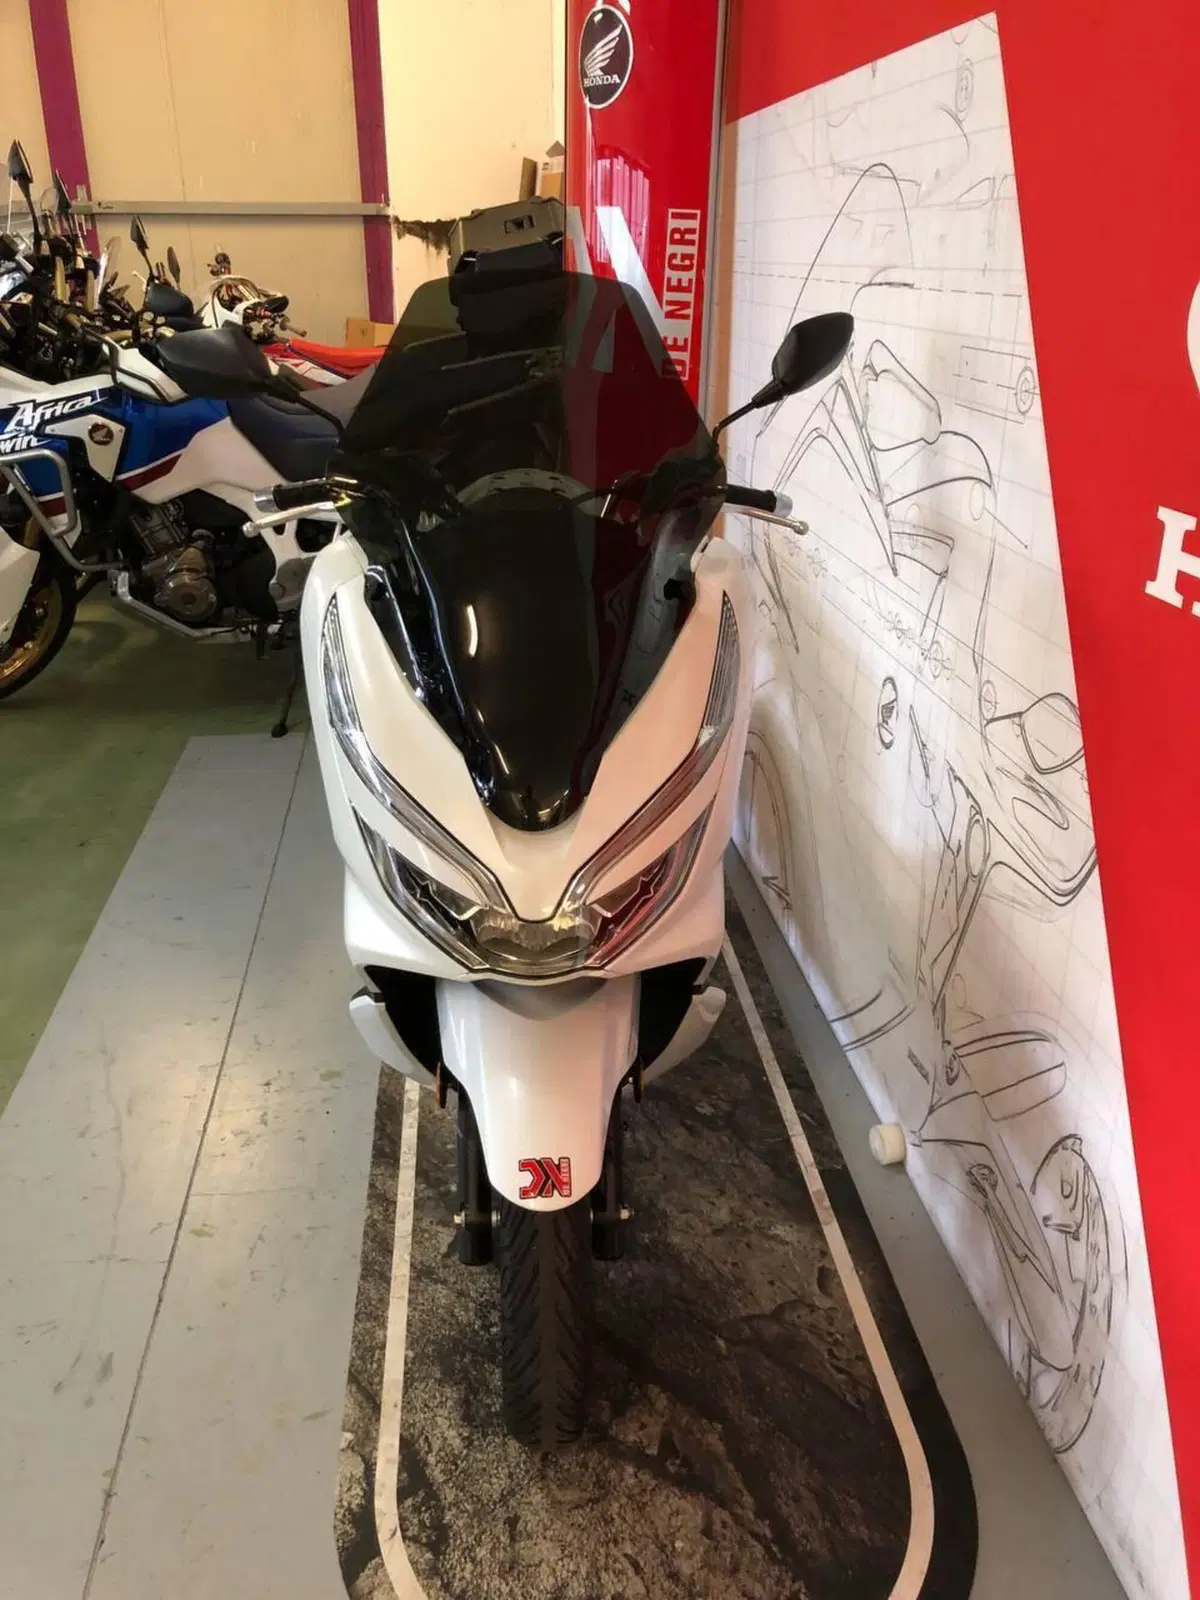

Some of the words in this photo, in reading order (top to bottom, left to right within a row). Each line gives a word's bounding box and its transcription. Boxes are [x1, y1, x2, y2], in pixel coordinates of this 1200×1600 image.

[583, 73, 621, 88] HONDA
[664, 211, 699, 320] NEGRI
[661, 335, 690, 380] DE
[4, 395, 106, 433] Africa
